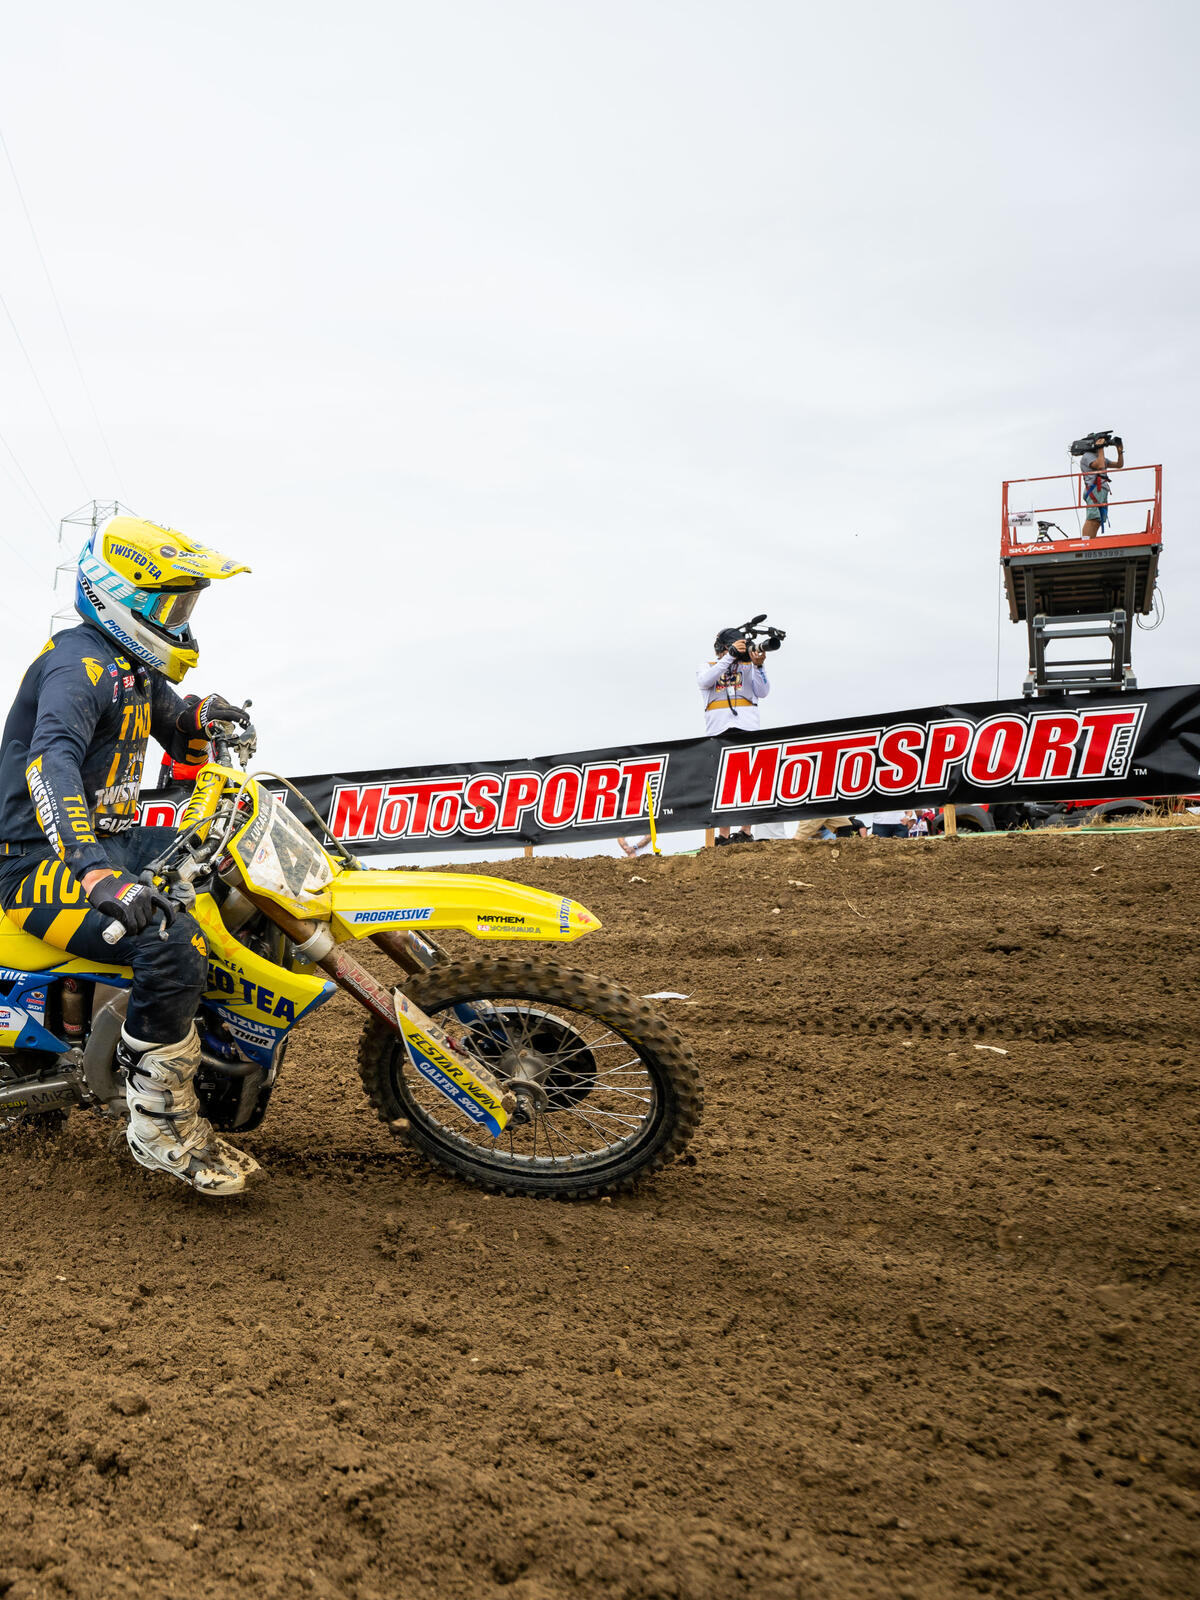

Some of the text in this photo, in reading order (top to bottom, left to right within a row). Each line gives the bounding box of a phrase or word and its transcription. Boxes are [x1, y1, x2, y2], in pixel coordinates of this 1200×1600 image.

[110, 543, 148, 567] TWISTED
[145, 561, 162, 581] TEA
[1008, 544, 1055, 554] SKYJACK
[81, 578, 106, 612] THOR
[104, 619, 166, 668] PROGRESSIVE
[119, 702, 151, 740] THO
[26, 766, 54, 826] TWISTED
[95, 782, 140, 806] TWIST
[63, 794, 96, 844] THOR
[250, 815, 268, 842] LUCAS
[354, 908, 431, 922] PROGRESSIVE
[477, 915, 525, 924] MAYHEM
[224, 960, 244, 976] TEA
[240, 977, 295, 1022] TEA
[218, 1007, 276, 1037] SUZUKI
[232, 1027, 269, 1046] THOR
[408, 1033, 463, 1078] ECSTAR
[419, 1062, 459, 1096] GALFER
